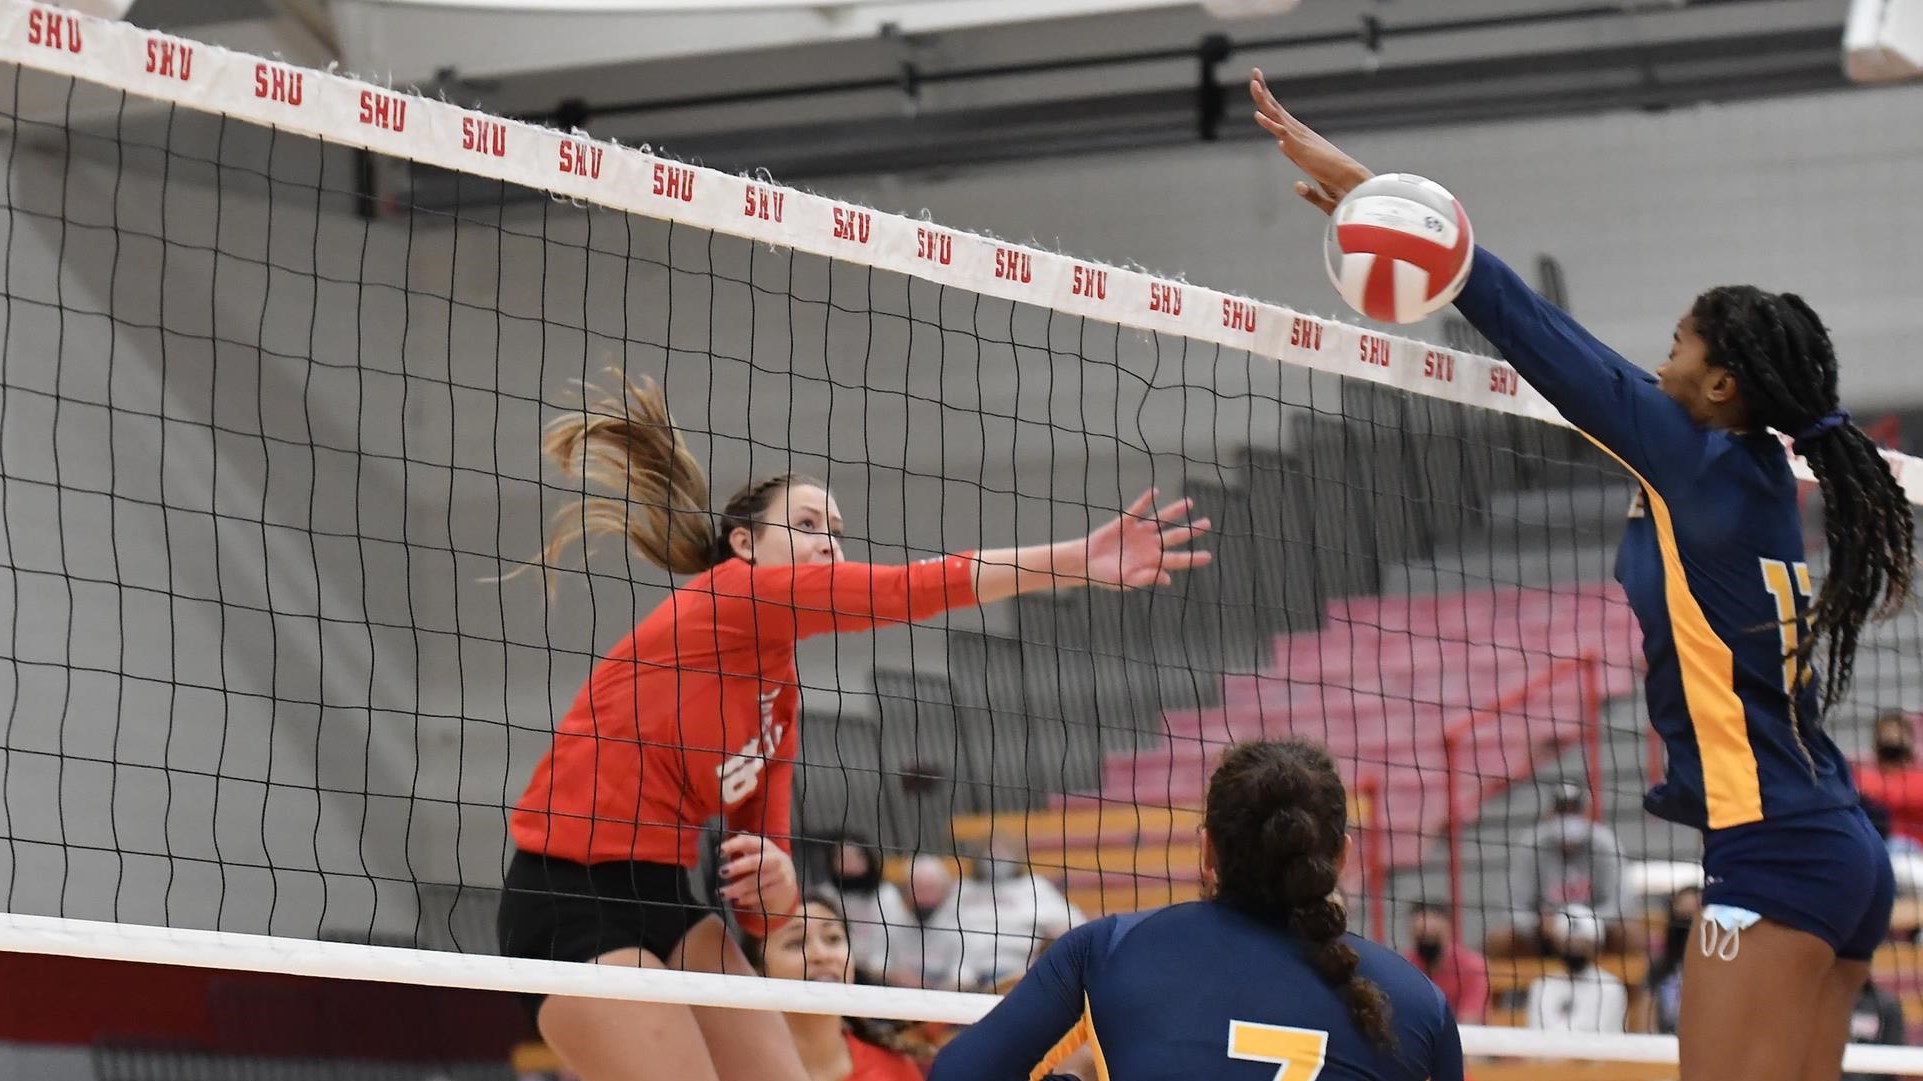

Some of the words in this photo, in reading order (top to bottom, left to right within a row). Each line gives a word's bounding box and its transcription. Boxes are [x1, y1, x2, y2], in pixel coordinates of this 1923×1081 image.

[30, 9, 82, 53] SHU
[147, 39, 192, 80] SHU
[255, 64, 302, 106] SHU
[360, 91, 406, 132] SHU
[463, 117, 505, 157] SHU
[559, 142, 603, 178] SHU
[653, 164, 694, 202] SHU
[745, 187, 783, 222] SHU
[834, 208, 870, 244] SHU
[917, 228, 952, 265] SHU
[995, 249, 1031, 283] SHU
[1073, 266, 1107, 300] SHU
[1150, 284, 1182, 316] SHU
[1222, 299, 1256, 332] SHU
[1292, 319, 1323, 351] SHU
[1360, 336, 1390, 367] SHU
[1425, 351, 1454, 382] SHU
[1227, 1019, 1329, 1081] 7
